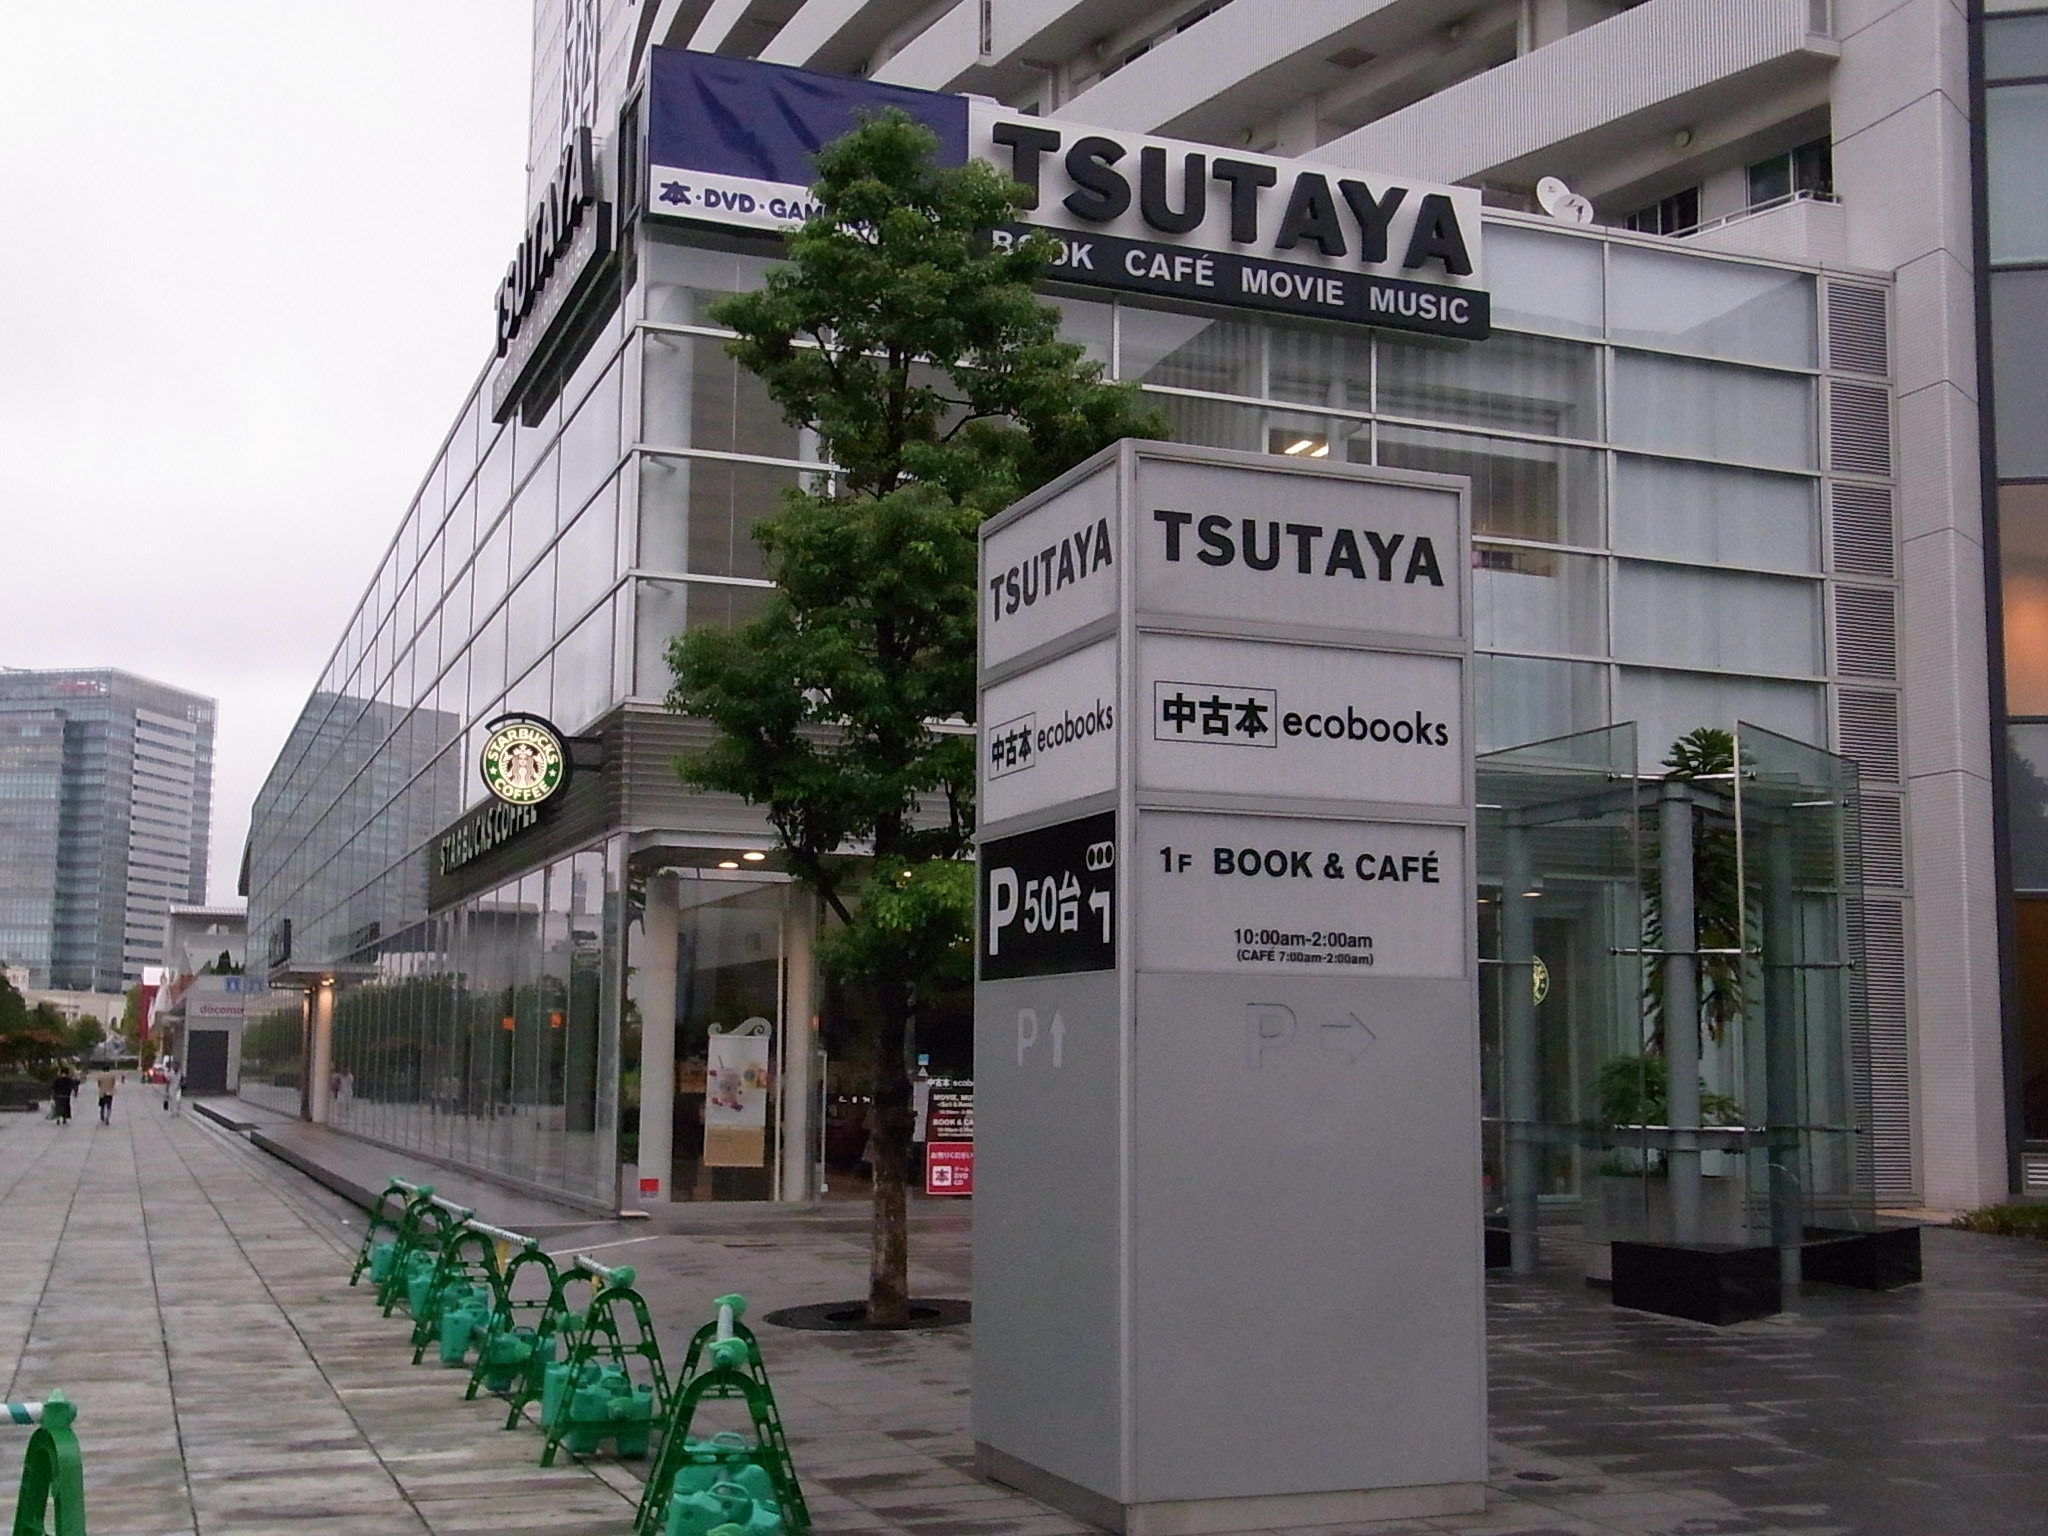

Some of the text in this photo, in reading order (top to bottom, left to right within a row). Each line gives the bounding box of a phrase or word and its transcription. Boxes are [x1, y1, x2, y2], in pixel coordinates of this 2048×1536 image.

[993, 122, 1474, 276] TSUTAYA
[1125, 249, 1215, 287] CAFÉ
[1240, 266, 1346, 306] MOVIE
[1368, 286, 1470, 325] MUSIC
[990, 517, 1113, 622] TSUTAYA
[1154, 509, 1445, 588] TSUTAYA
[992, 698, 1114, 771] 中古本 ecobooks
[1163, 692, 1450, 747] 中古本 ecobooks
[487, 728, 560, 801] STARBUCKS COFFEE
[1159, 846, 1441, 884] 1F BOOK & CAFÉ
[988, 866, 1019, 956] P
[1234, 928, 1373, 949] 10:00am-2:00am
[1016, 1008, 1039, 1067] P
[932, 1118, 955, 1126] BOOK
